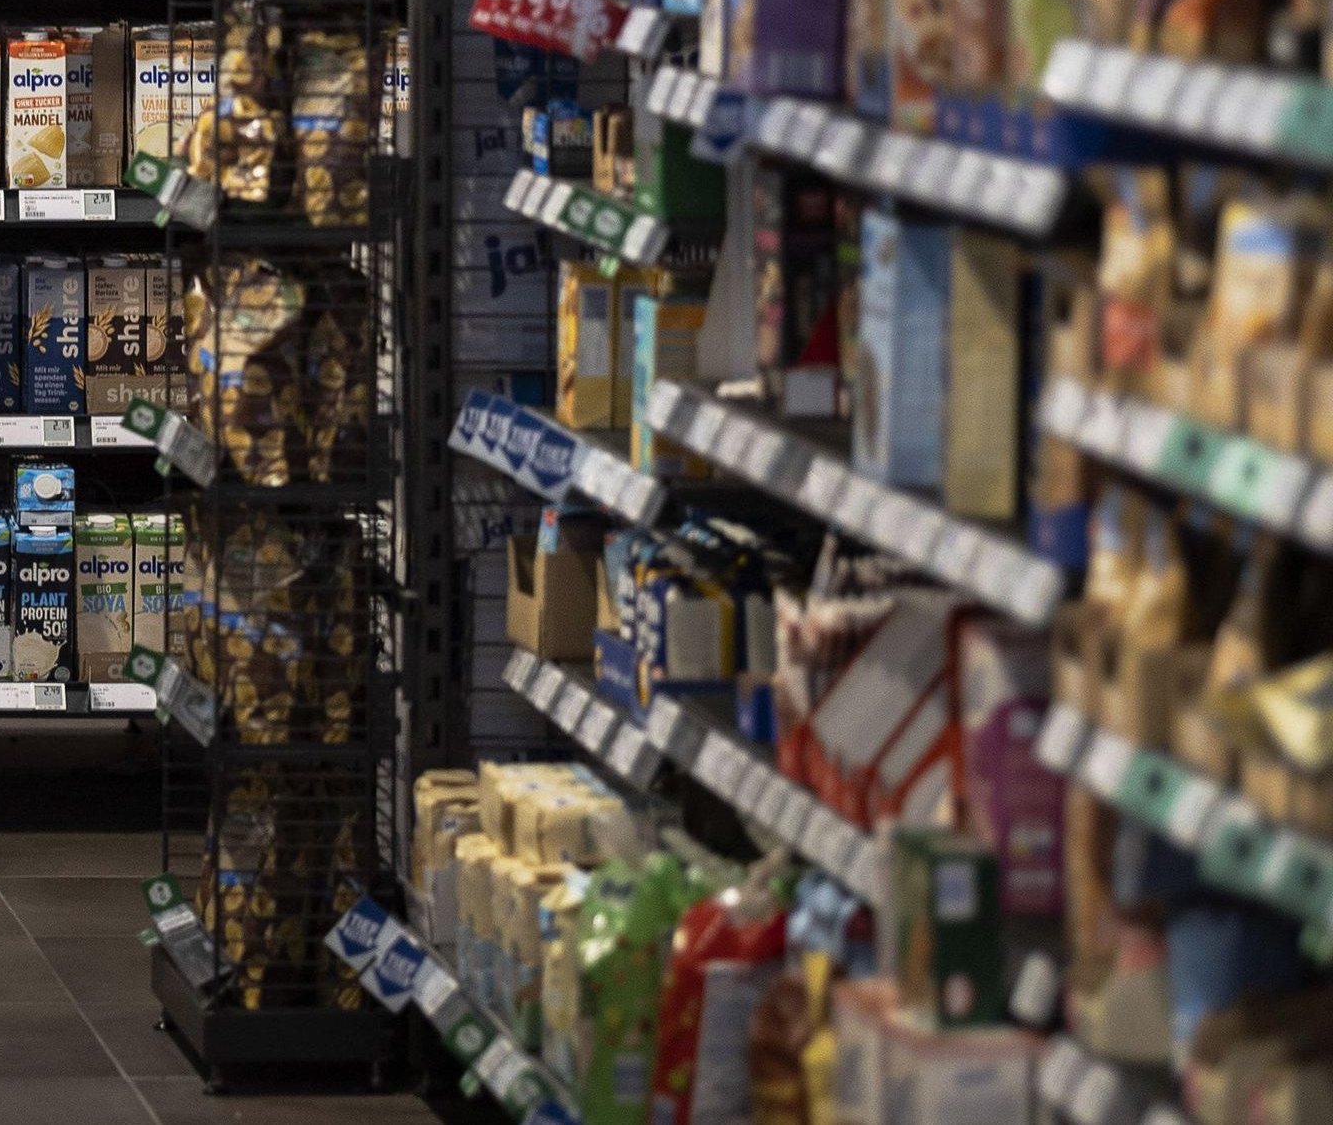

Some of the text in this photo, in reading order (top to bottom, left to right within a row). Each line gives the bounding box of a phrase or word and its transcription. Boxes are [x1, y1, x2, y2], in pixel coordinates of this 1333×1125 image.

[13, 69, 63, 92] alpro
[57, 277, 80, 358] share
[118, 275, 140, 356] share
[19, 562, 70, 587] alpro
[21, 592, 67, 606] PLANT
[21, 607, 68, 620] PROTEIN
